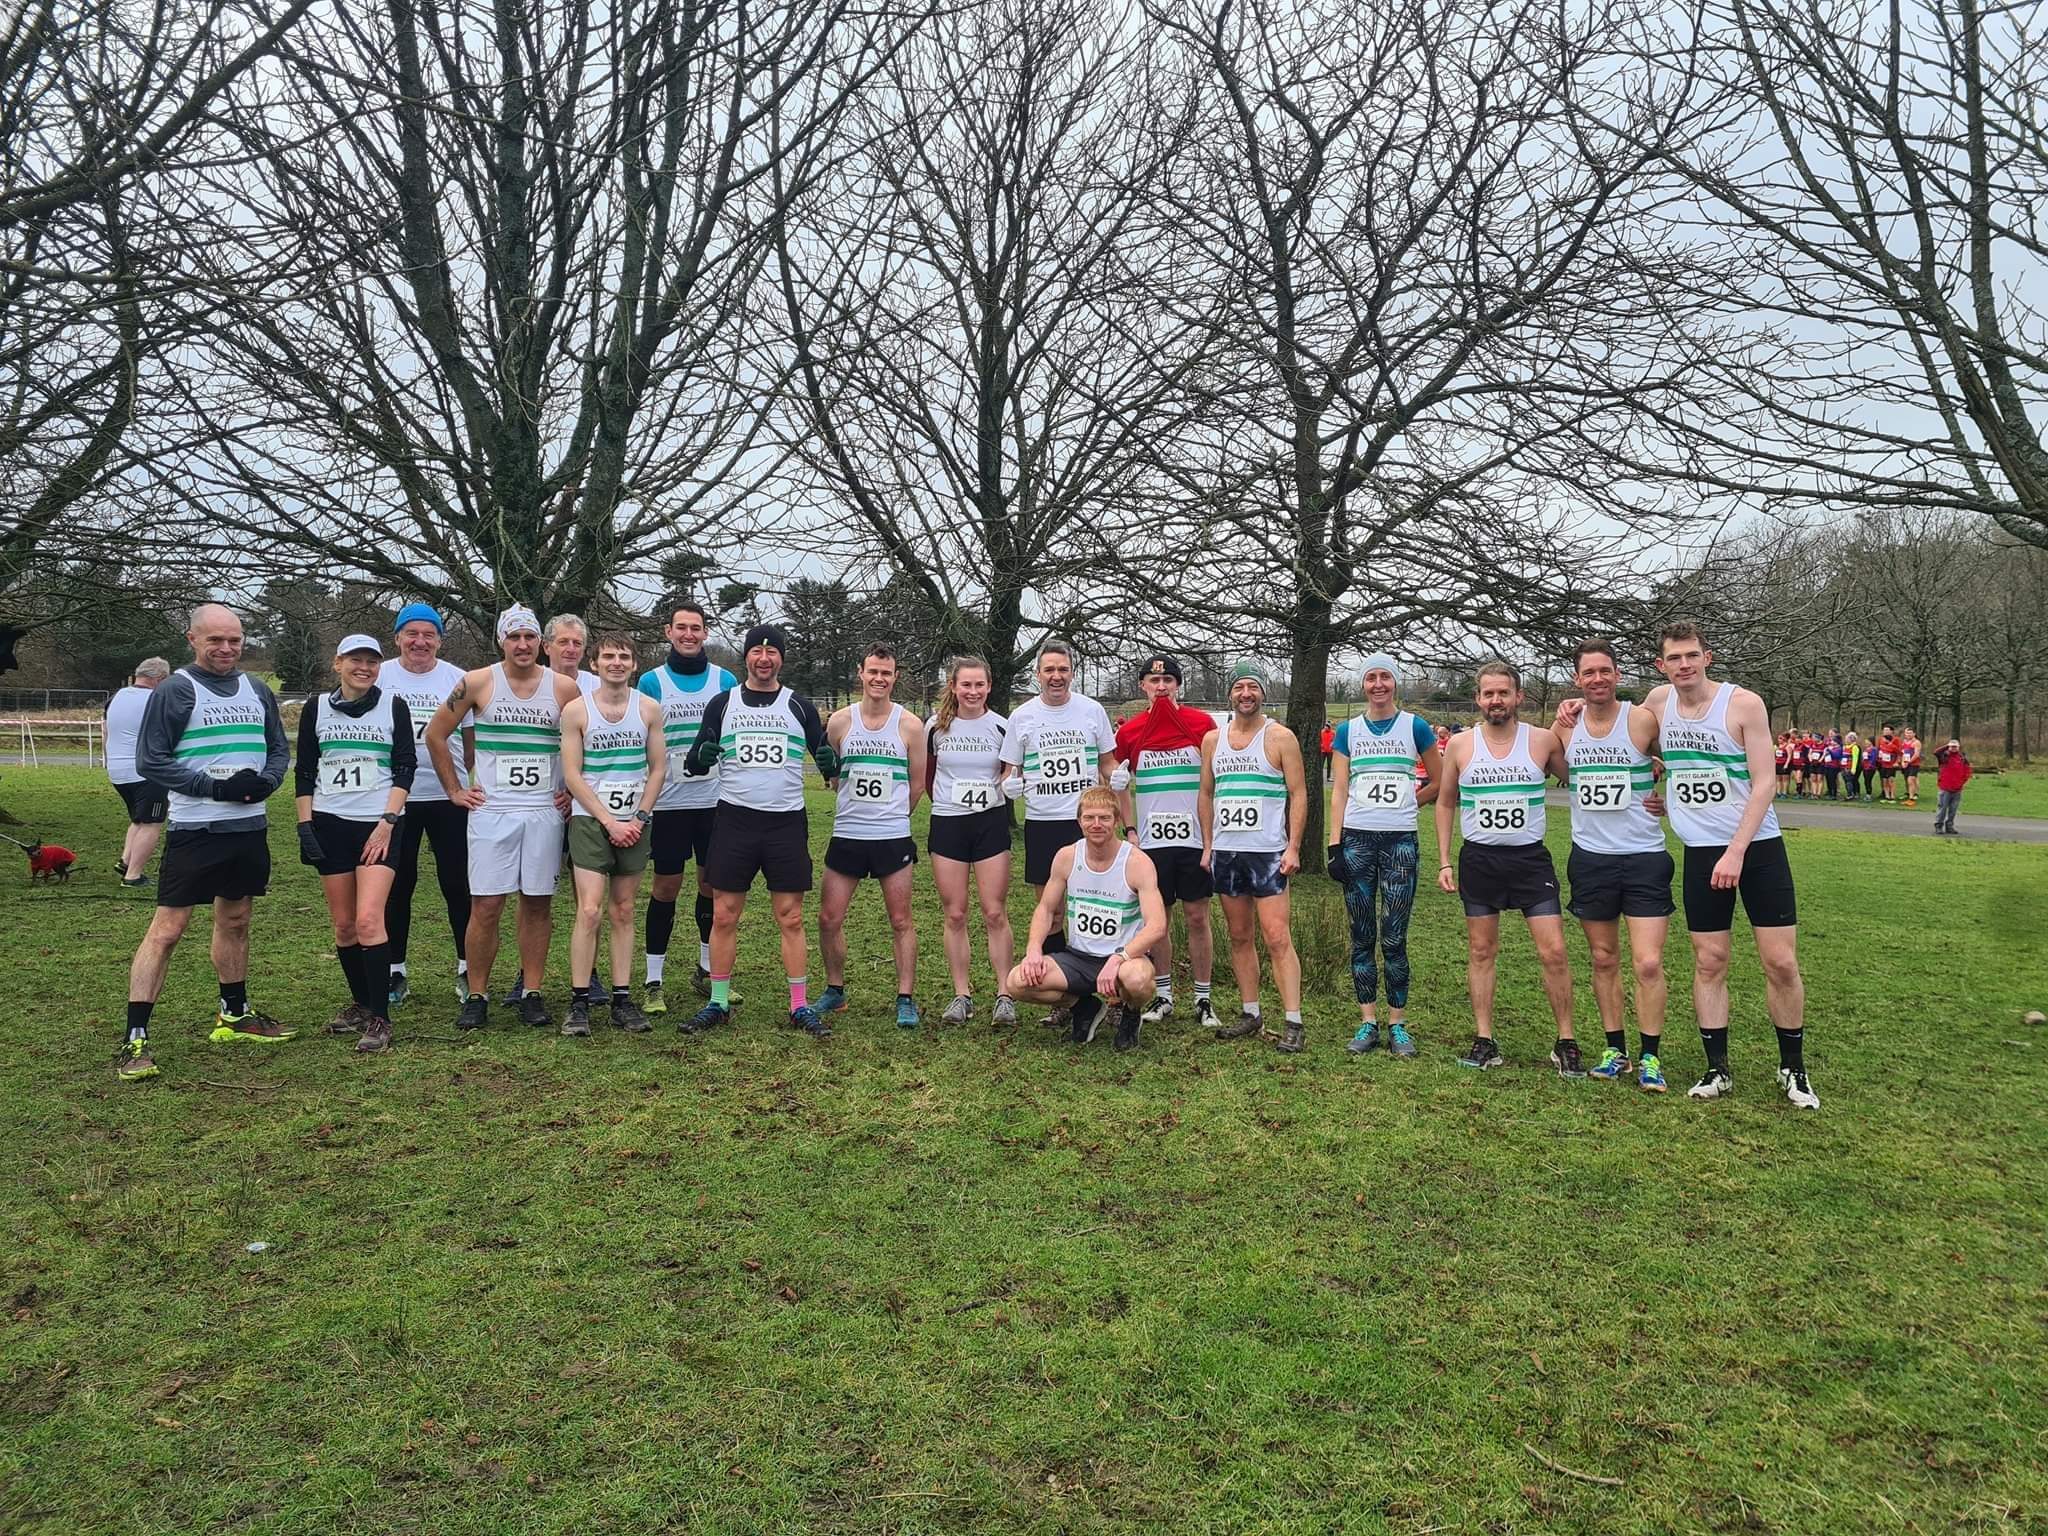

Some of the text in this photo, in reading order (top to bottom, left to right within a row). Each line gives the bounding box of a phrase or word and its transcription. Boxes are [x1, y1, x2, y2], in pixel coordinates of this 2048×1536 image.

[203, 705, 260, 716] SWANSEA
[496, 706, 551, 717] SWANSEA
[494, 714, 552, 726] HARRIERS
[731, 720, 788, 730] HARRIERS
[327, 724, 382, 734] SWANSEA
[414, 721, 428, 740] 7
[324, 732, 384, 742] HARRIERS
[592, 731, 642, 742] SWANSEA
[1040, 730, 1084, 740] SWANSEA
[1668, 730, 1716, 742] SWANSEA
[592, 740, 642, 750] HARRIERS
[849, 740, 896, 750] SWANSEA
[942, 744, 993, 752] HARRIERS
[1039, 738, 1086, 748] HARRIERS
[1356, 740, 1404, 748] SWANSEA
[1666, 740, 1720, 752] HARRIERS
[740, 744, 783, 764] 353
[848, 748, 897, 757] HARRIERS
[1144, 749, 1189, 760] SWANSEA
[1355, 748, 1406, 756] HARRIERS
[1576, 746, 1628, 756] SWANSEA
[1144, 758, 1192, 768] HARRIERS
[1217, 756, 1258, 764] SWANSEA
[1574, 756, 1632, 766] HARRIERS
[1043, 757, 1080, 778] 391
[1216, 764, 1260, 773] HARRIERS
[1473, 766, 1528, 776] SWANSEA
[332, 766, 361, 788] 41
[510, 766, 540, 787] 55
[1472, 774, 1532, 784] HARRIERS
[856, 778, 882, 798] 56
[1676, 781, 1726, 804] 359
[961, 790, 988, 808] 44
[1368, 784, 1398, 804] 45
[1580, 784, 1626, 806] 357
[608, 790, 635, 810] 54
[1220, 808, 1258, 827] 349
[1480, 808, 1524, 829] 358
[1152, 821, 1190, 840] 363
[1078, 913, 1117, 936] 366
